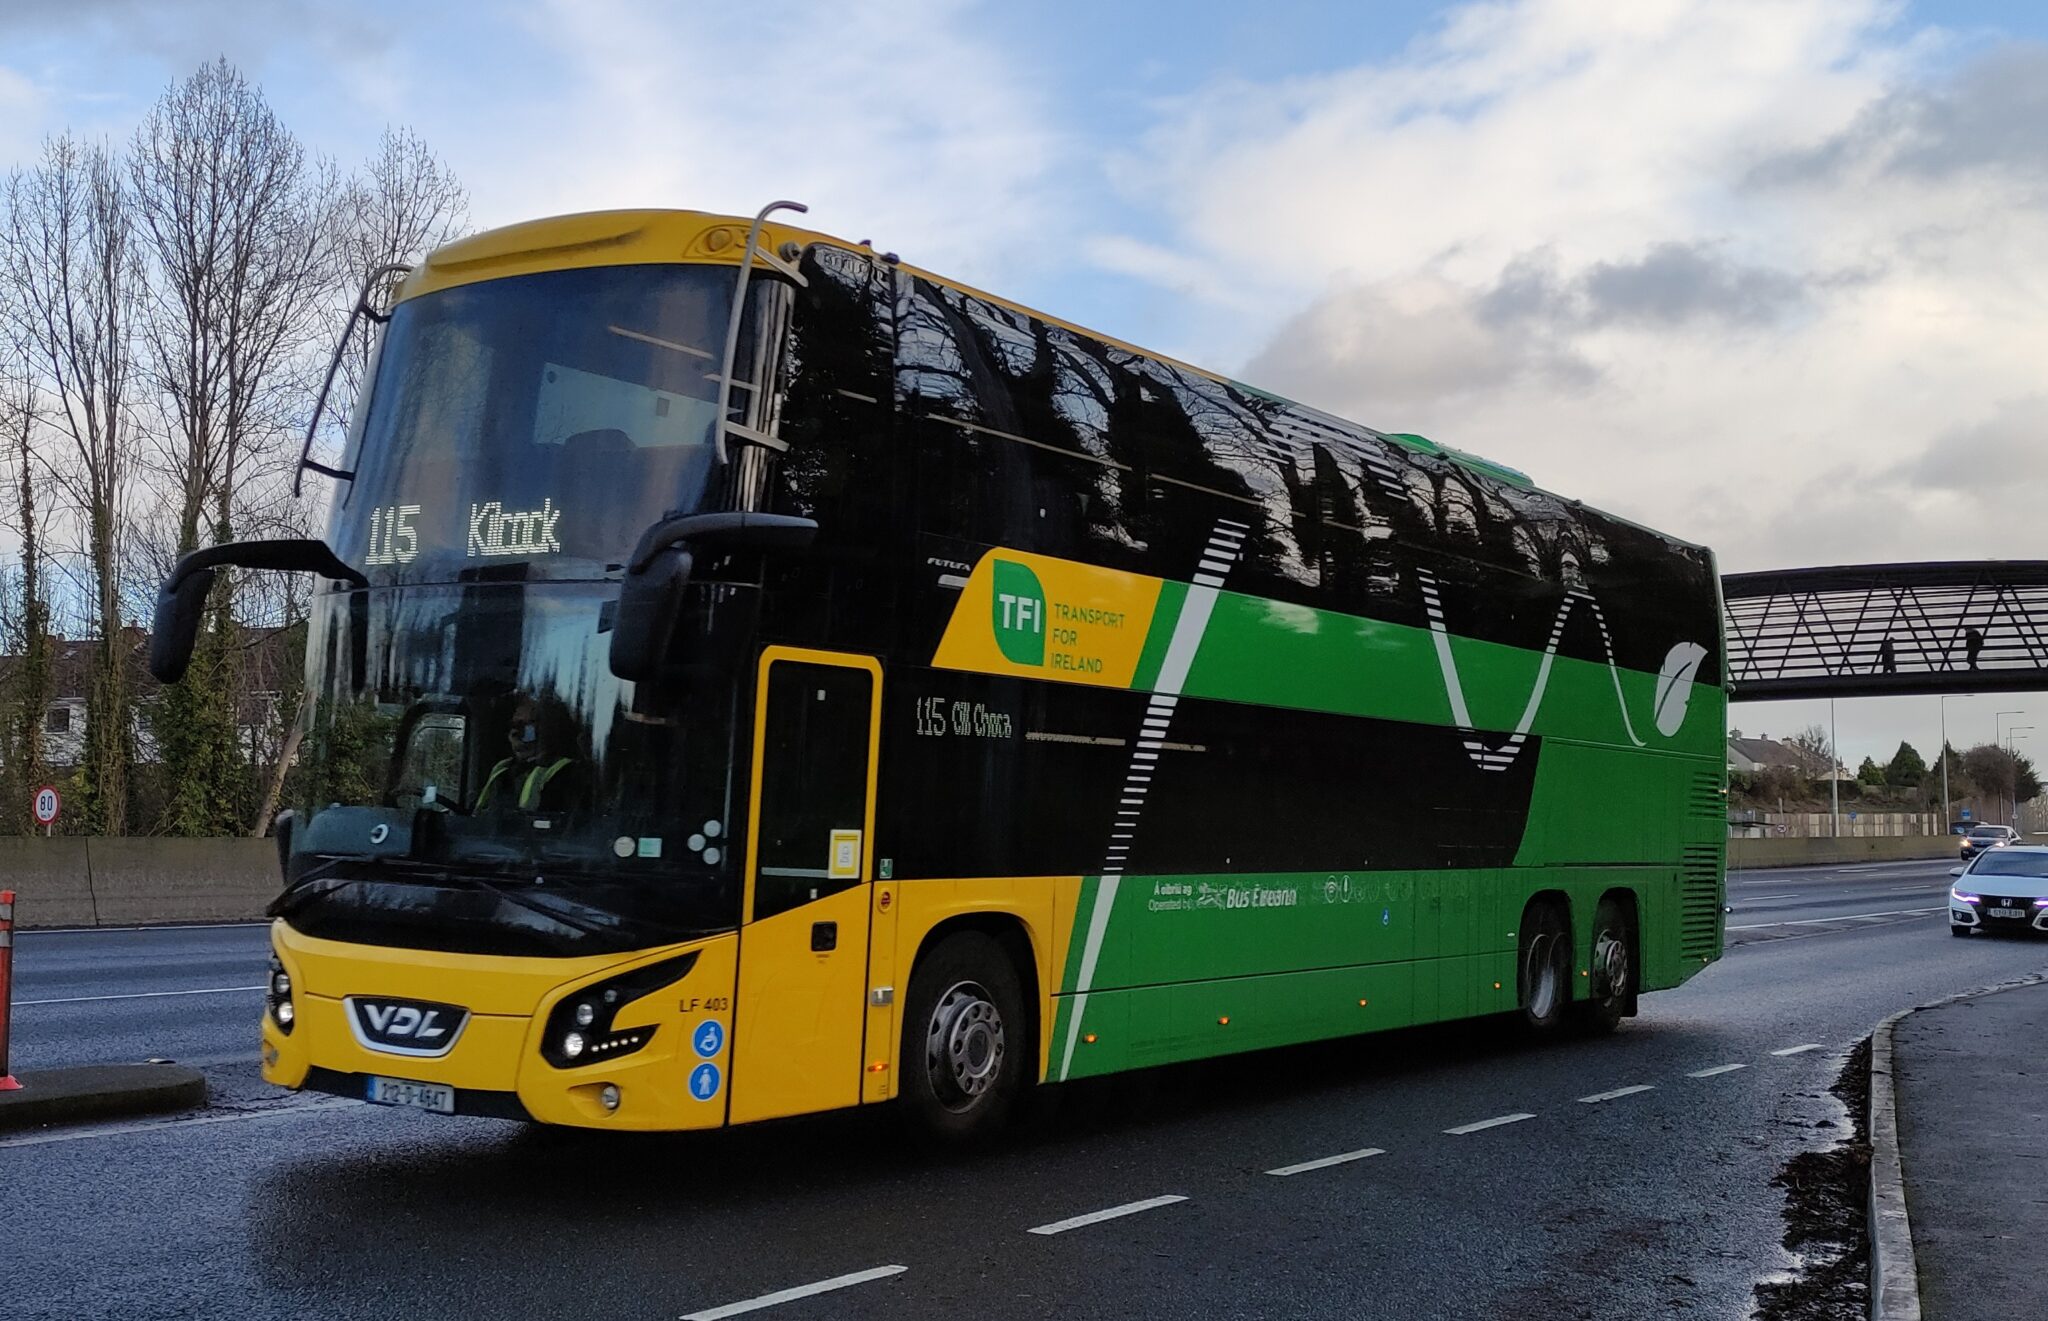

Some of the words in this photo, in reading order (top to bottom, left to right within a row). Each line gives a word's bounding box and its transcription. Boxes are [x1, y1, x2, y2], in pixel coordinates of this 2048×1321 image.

[365, 505, 421, 565] 115
[927, 557, 971, 571] FUTURA
[999, 593, 1041, 634] TFI
[1054, 603, 1126, 628] TRANSPORT
[1053, 628, 1077, 646] FOR
[1051, 652, 1103, 673] IRELAND
[916, 696, 946, 736] 115
[40, 796, 53, 811] 80
[680, 999, 699, 1012] LF
[704, 998, 728, 1011] 403
[364, 1004, 446, 1038] VDL
